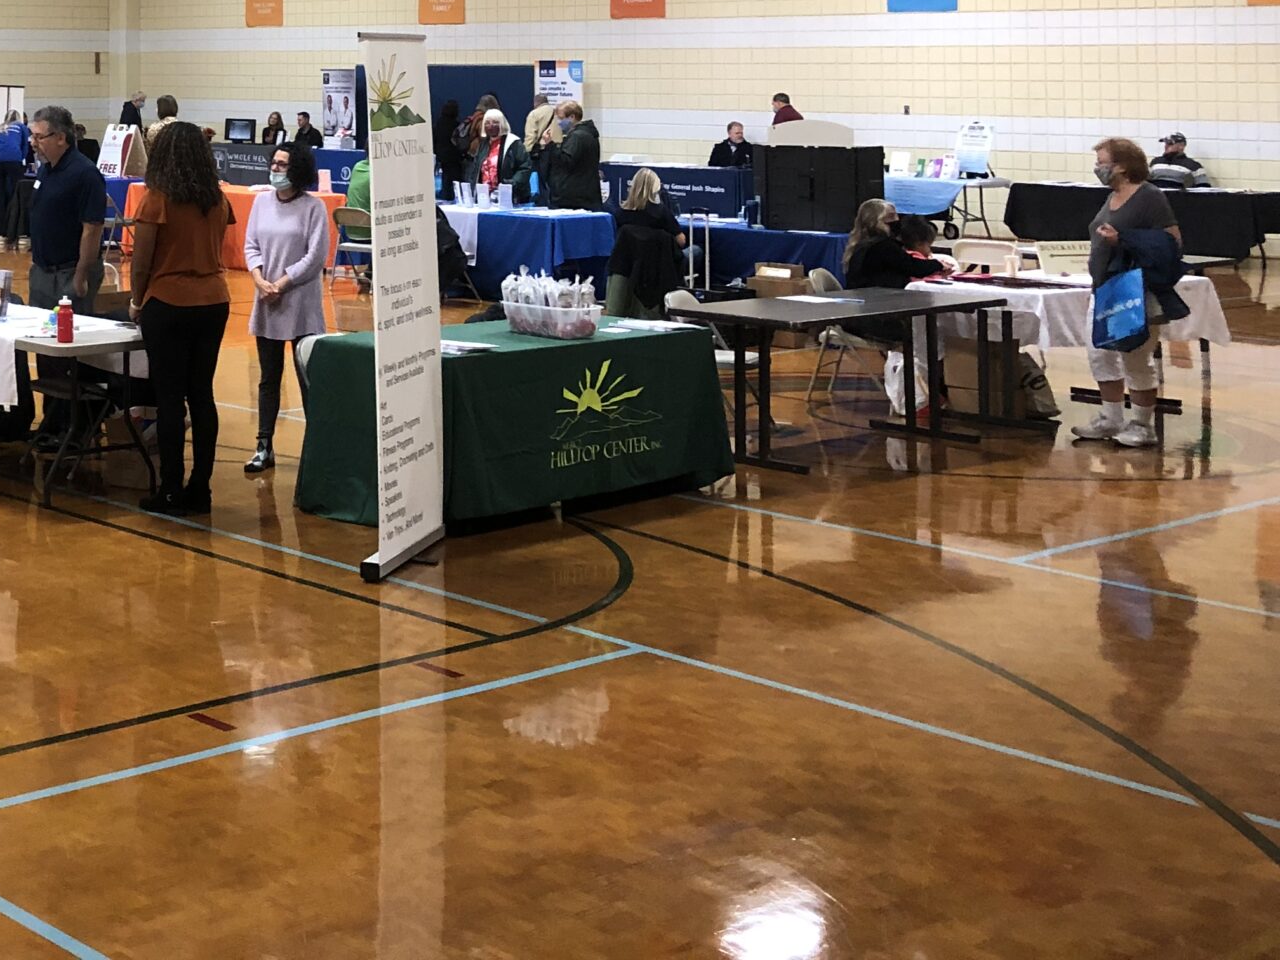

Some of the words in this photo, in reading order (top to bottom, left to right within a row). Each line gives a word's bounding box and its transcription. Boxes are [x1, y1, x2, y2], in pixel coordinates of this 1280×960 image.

[227, 152, 251, 162] WHOLE
[252, 154, 268, 163] HEA
[100, 163, 118, 174] FREE
[671, 183, 691, 192] General
[692, 184, 704, 192] Josh
[704, 185, 725, 193] Shapiro
[551, 444, 600, 469] HILLTOP
[603, 436, 650, 459] CENTER
